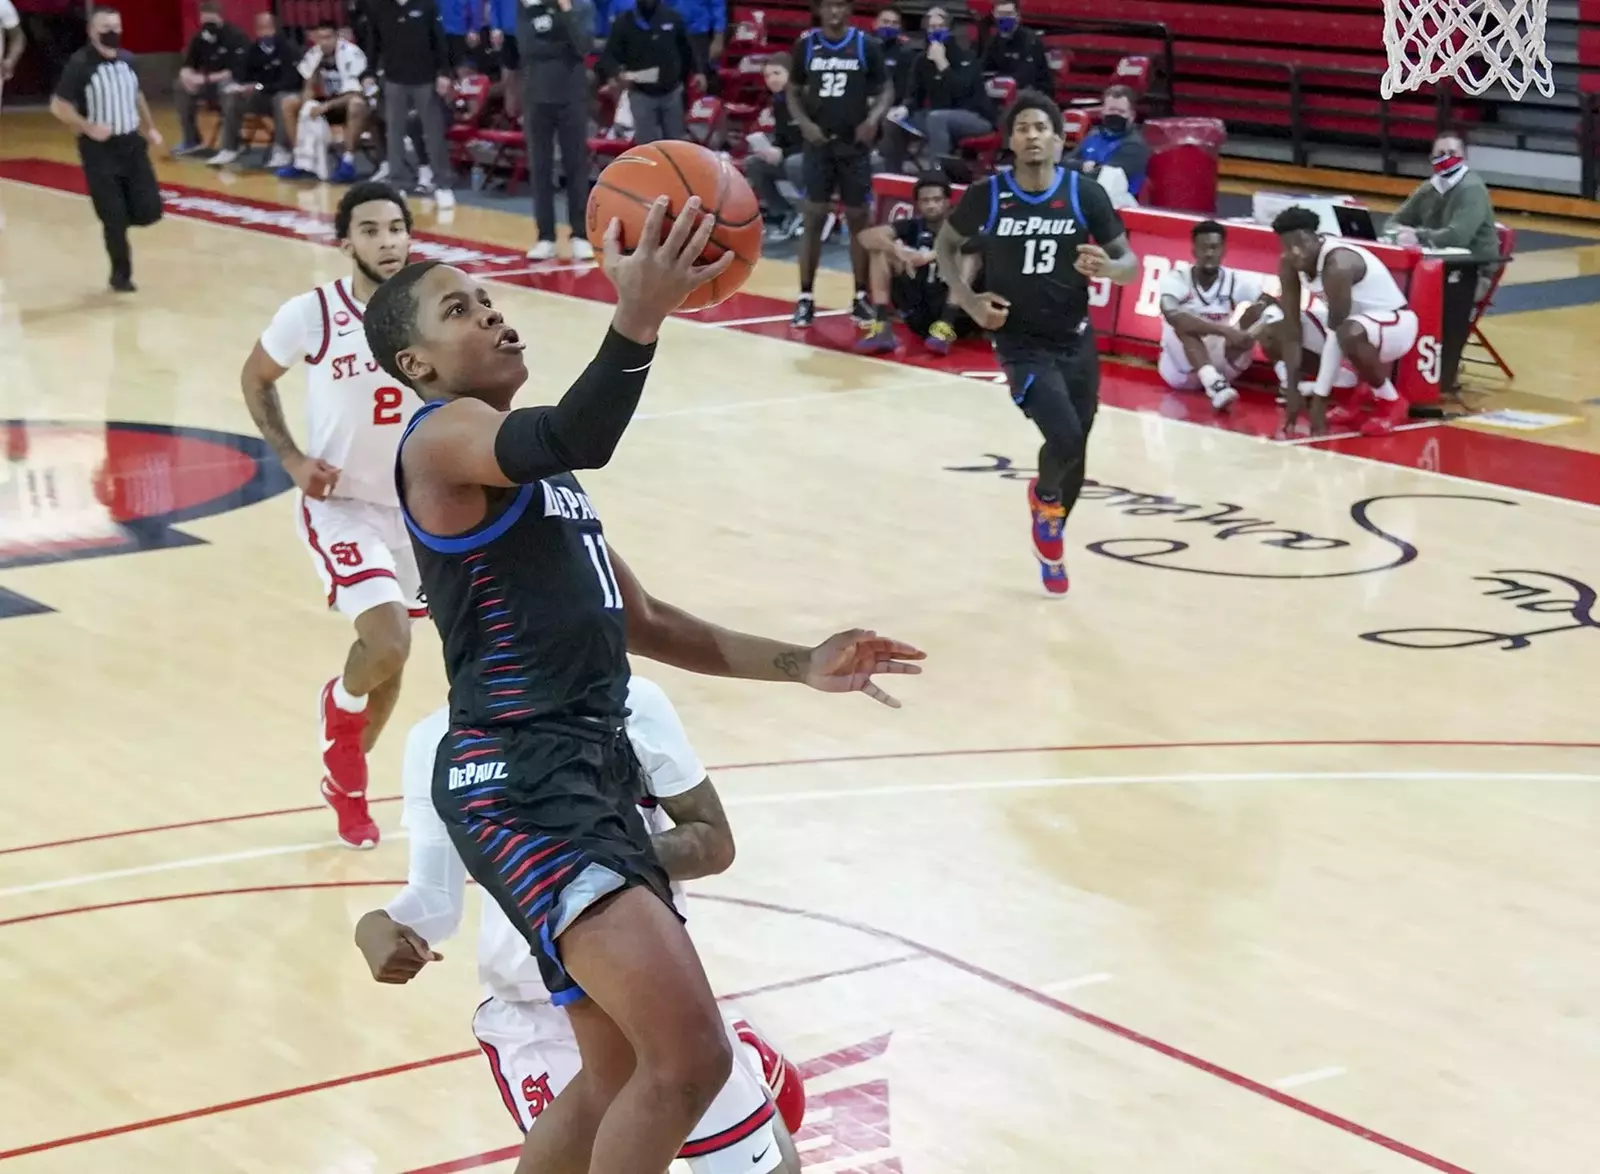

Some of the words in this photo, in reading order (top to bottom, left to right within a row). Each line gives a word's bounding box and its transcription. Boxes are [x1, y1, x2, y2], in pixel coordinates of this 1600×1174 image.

[818, 72, 848, 97] 32
[1021, 239, 1058, 275] 13
[372, 386, 403, 425] 2
[582, 533, 623, 609] 11
